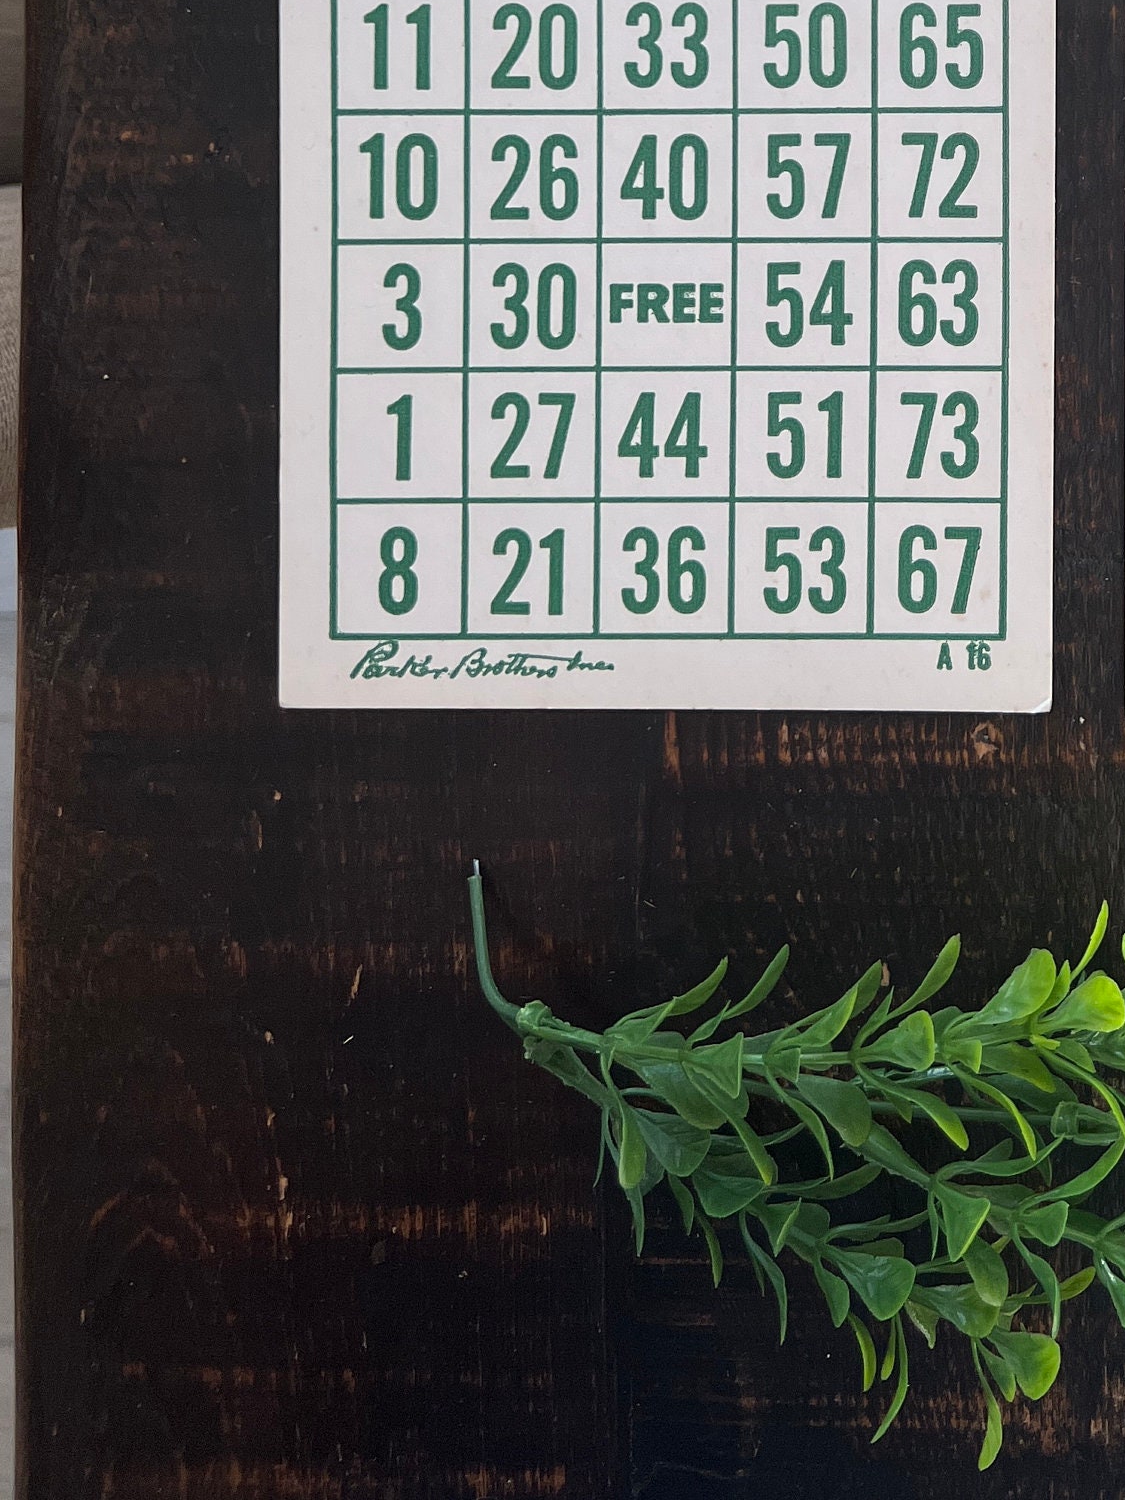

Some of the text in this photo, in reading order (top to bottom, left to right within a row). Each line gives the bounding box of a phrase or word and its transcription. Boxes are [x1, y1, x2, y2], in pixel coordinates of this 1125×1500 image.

[364, 2, 983, 90] 11 20 33 50 65
[359, 132, 979, 221] 10 26 40 57 72
[382, 259, 979, 351] 3 30 FREE 54 63
[387, 391, 979, 481] 1 27 44 51 73
[378, 525, 982, 616] 8 21 36 53 67
[350, 639, 449, 679] Parker
[450, 647, 559, 679] Brothers
[937, 641, 992, 671] A 16
